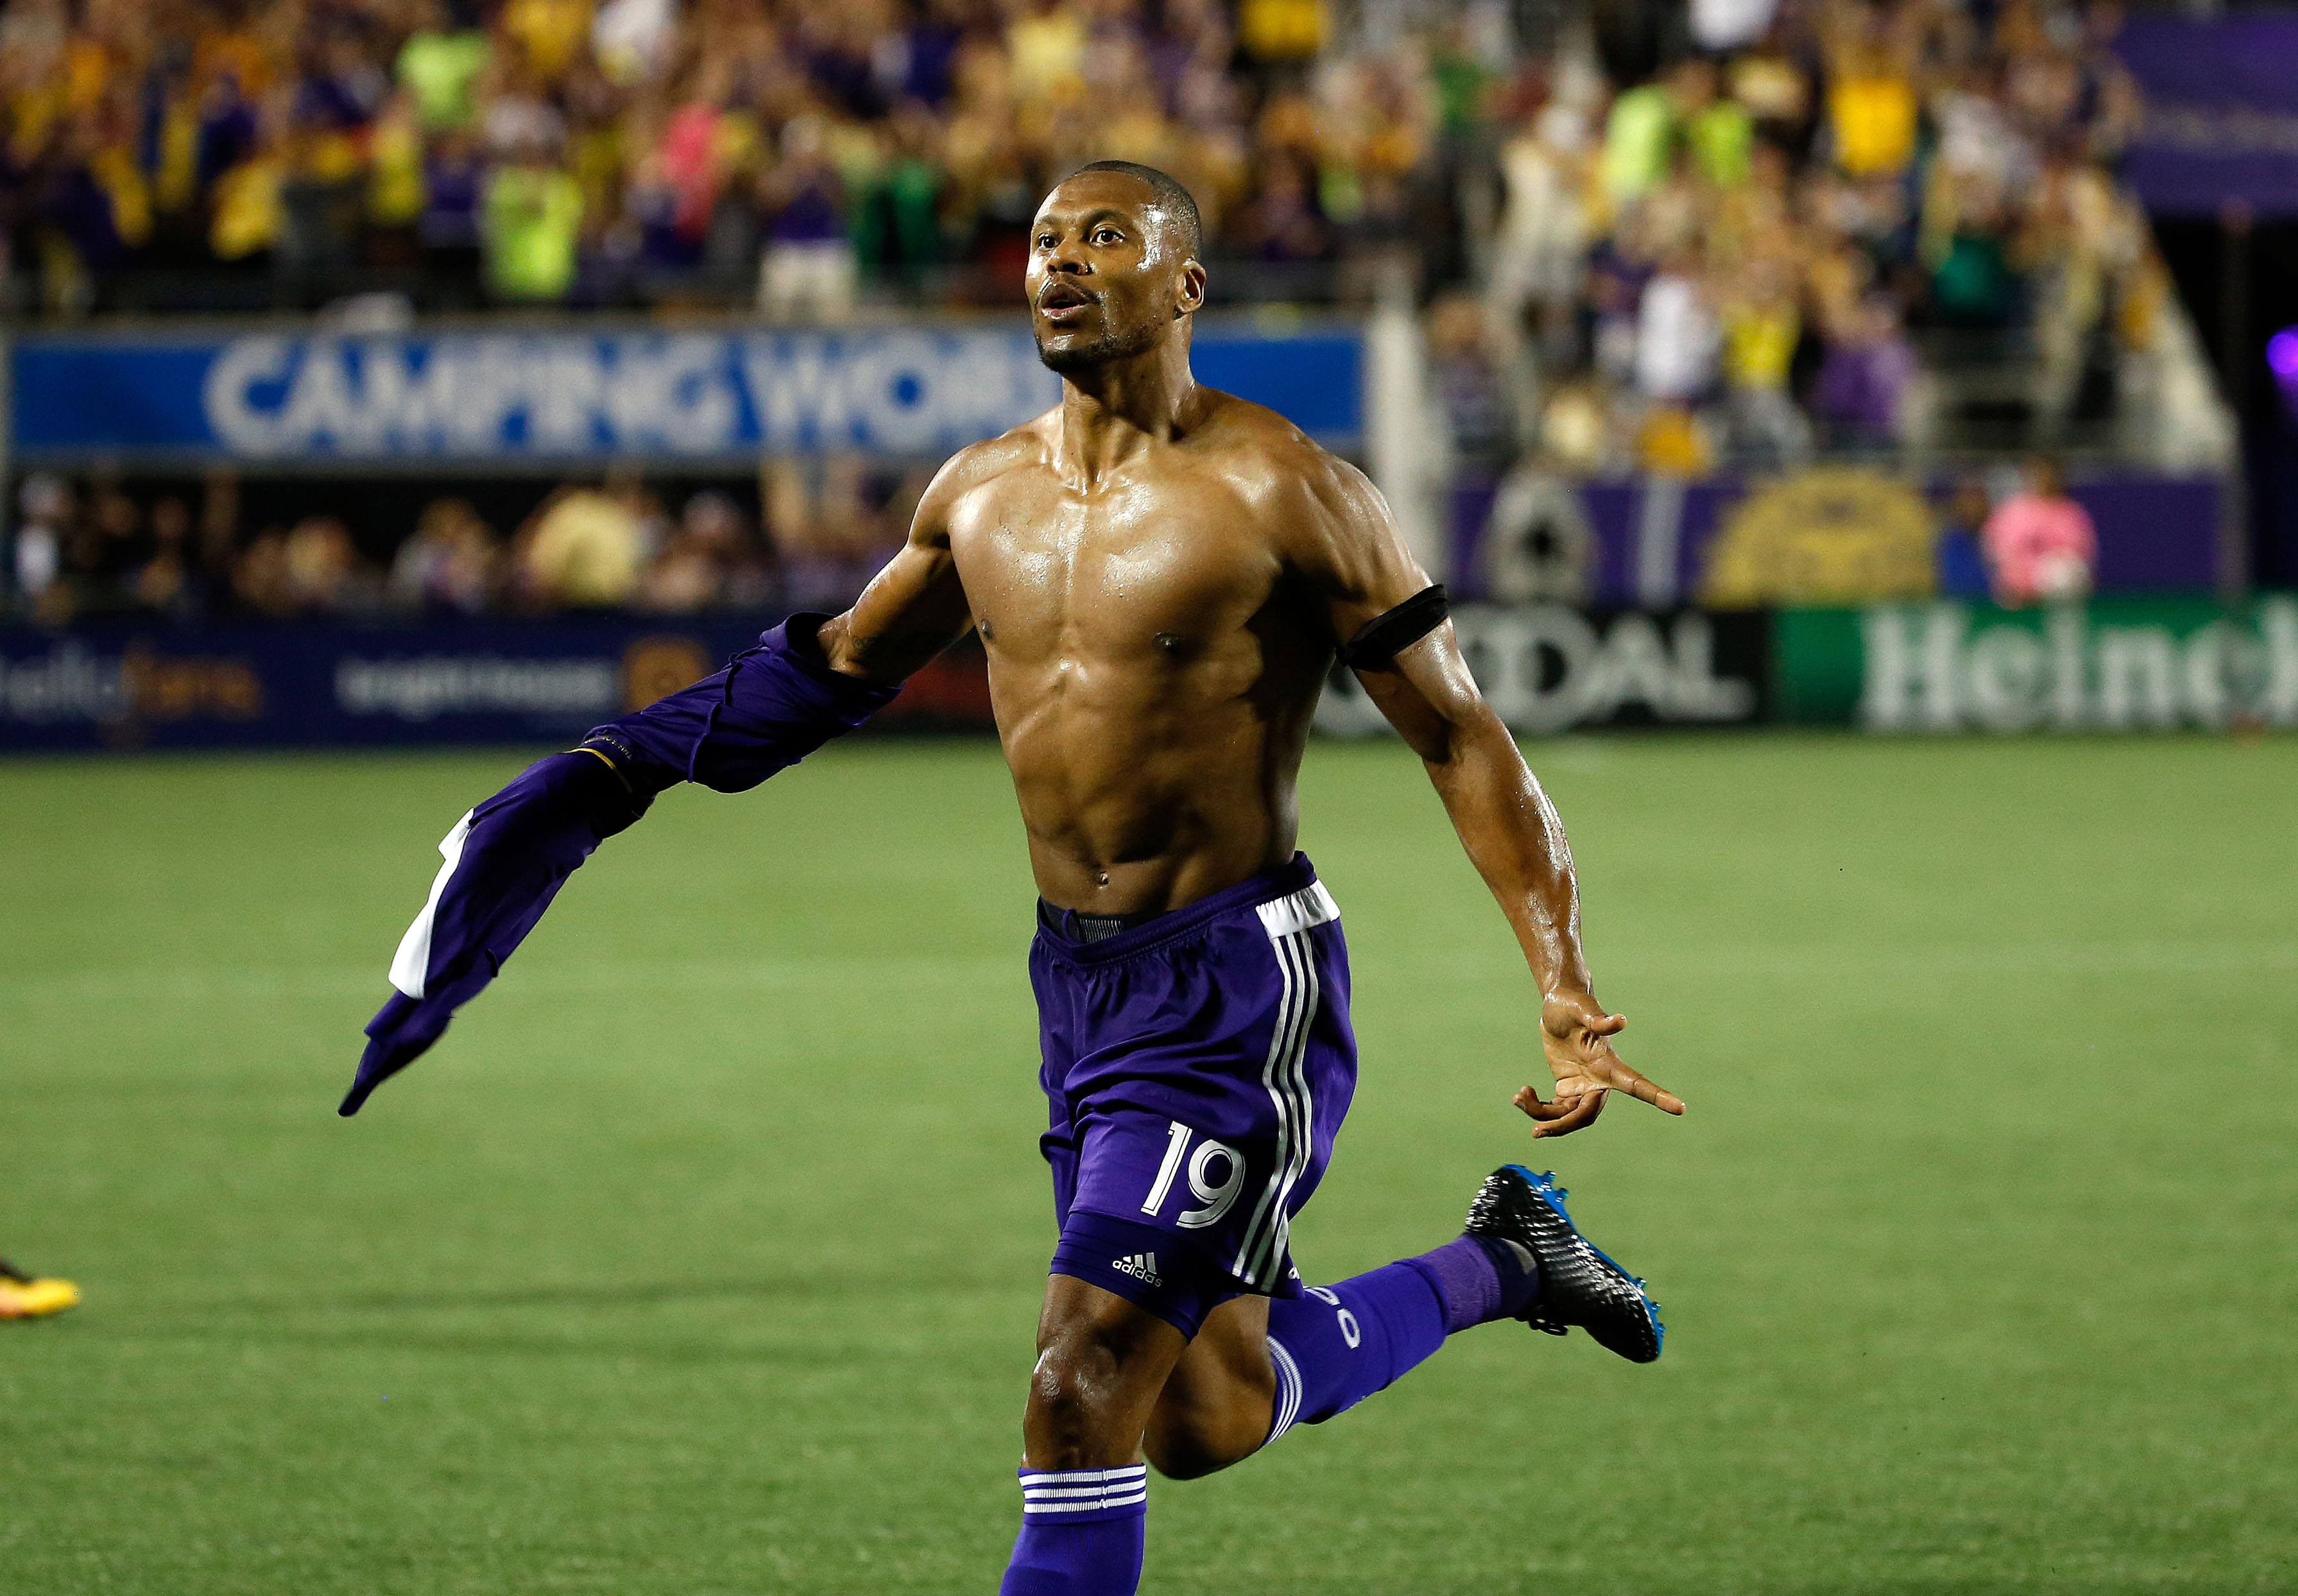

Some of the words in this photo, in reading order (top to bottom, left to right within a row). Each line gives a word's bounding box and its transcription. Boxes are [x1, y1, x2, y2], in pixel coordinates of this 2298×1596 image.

[204, 330, 739, 458] CAMPING
[742, 330, 1062, 458] WOR
[1140, 1120, 1246, 1229] 19
[1112, 1260, 1163, 1287] adidas
